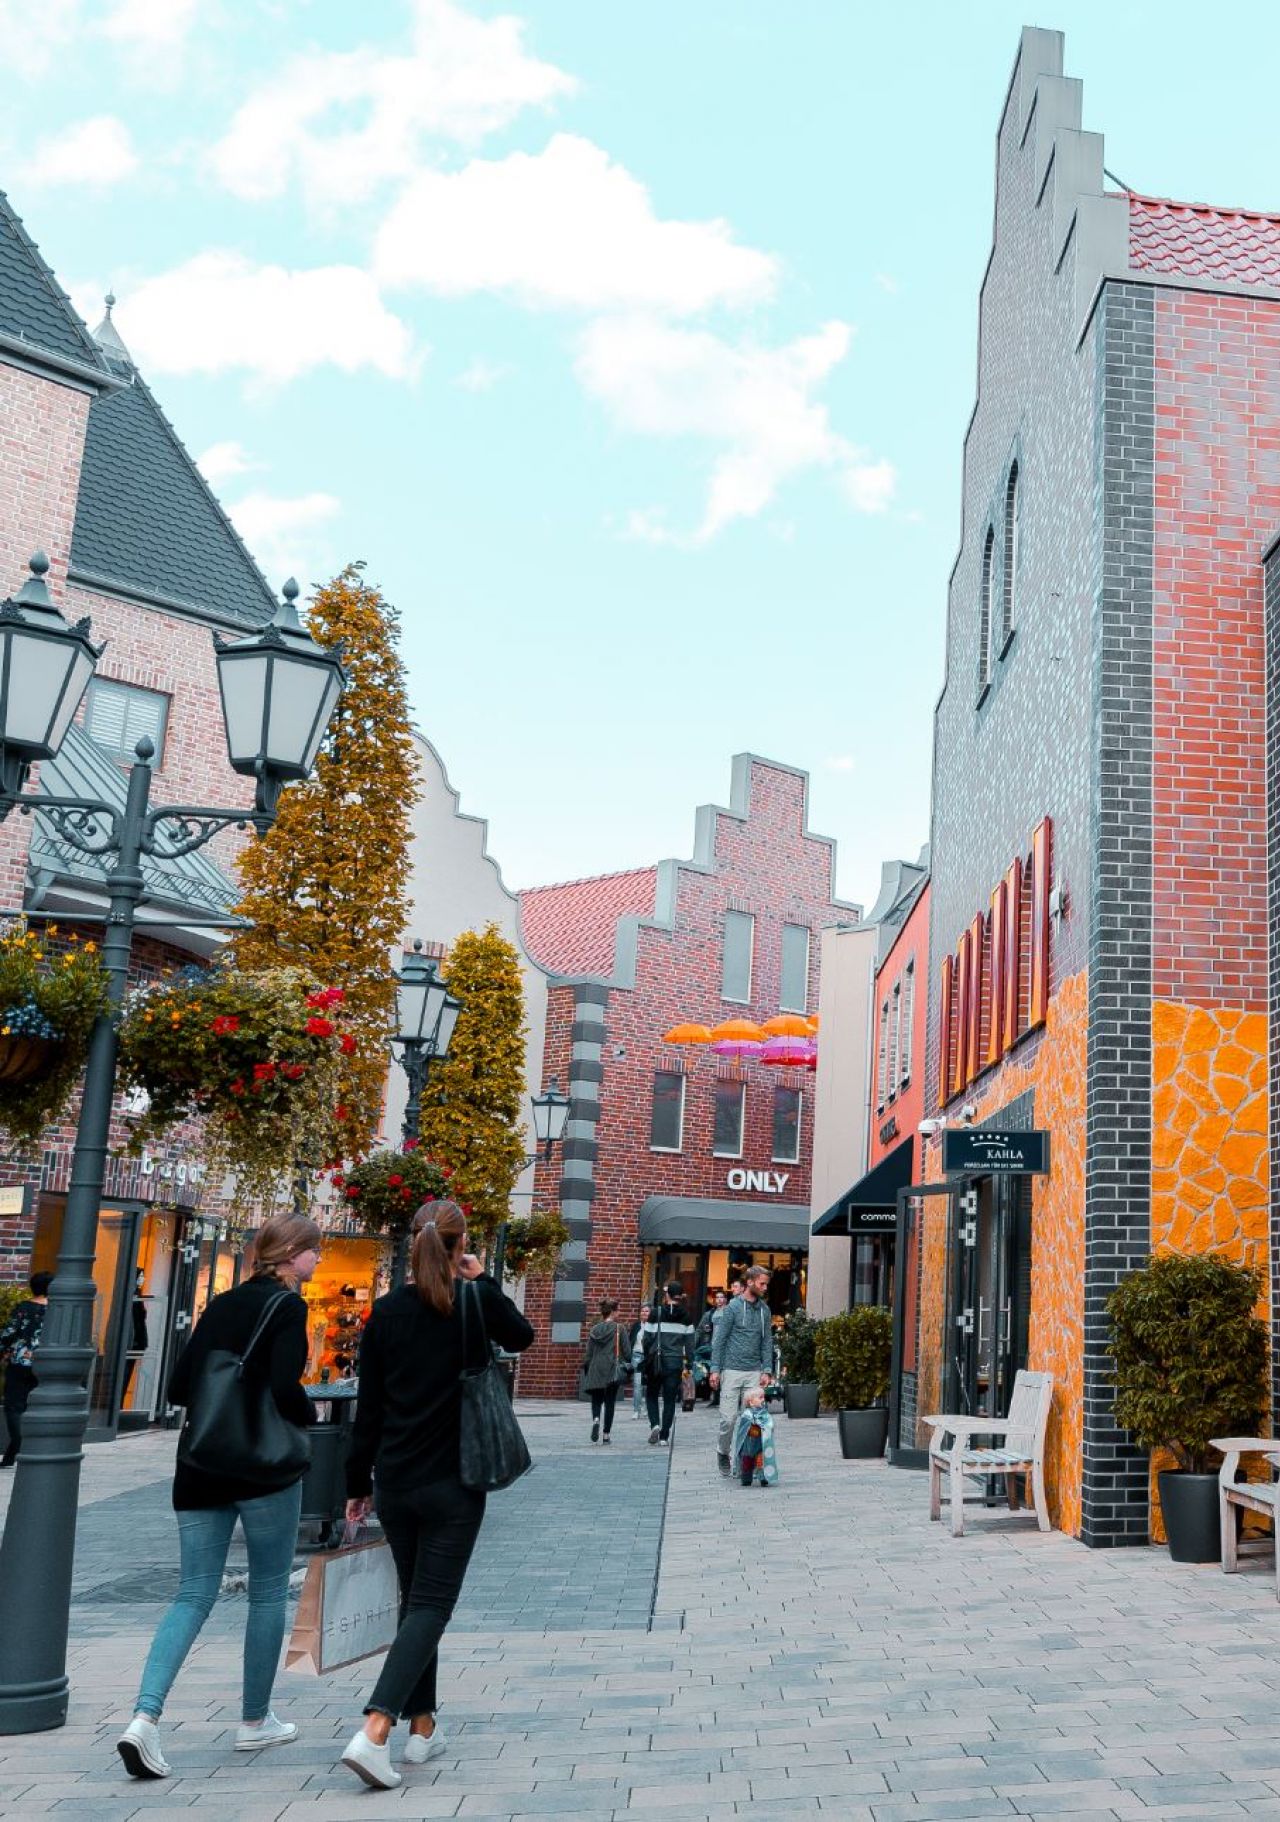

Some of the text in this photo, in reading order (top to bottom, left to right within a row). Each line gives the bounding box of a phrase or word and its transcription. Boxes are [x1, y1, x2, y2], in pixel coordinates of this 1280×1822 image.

[986, 1149, 1025, 1159] KAHLA
[727, 1168, 790, 1193] ONLY
[860, 1213, 897, 1222] comma
